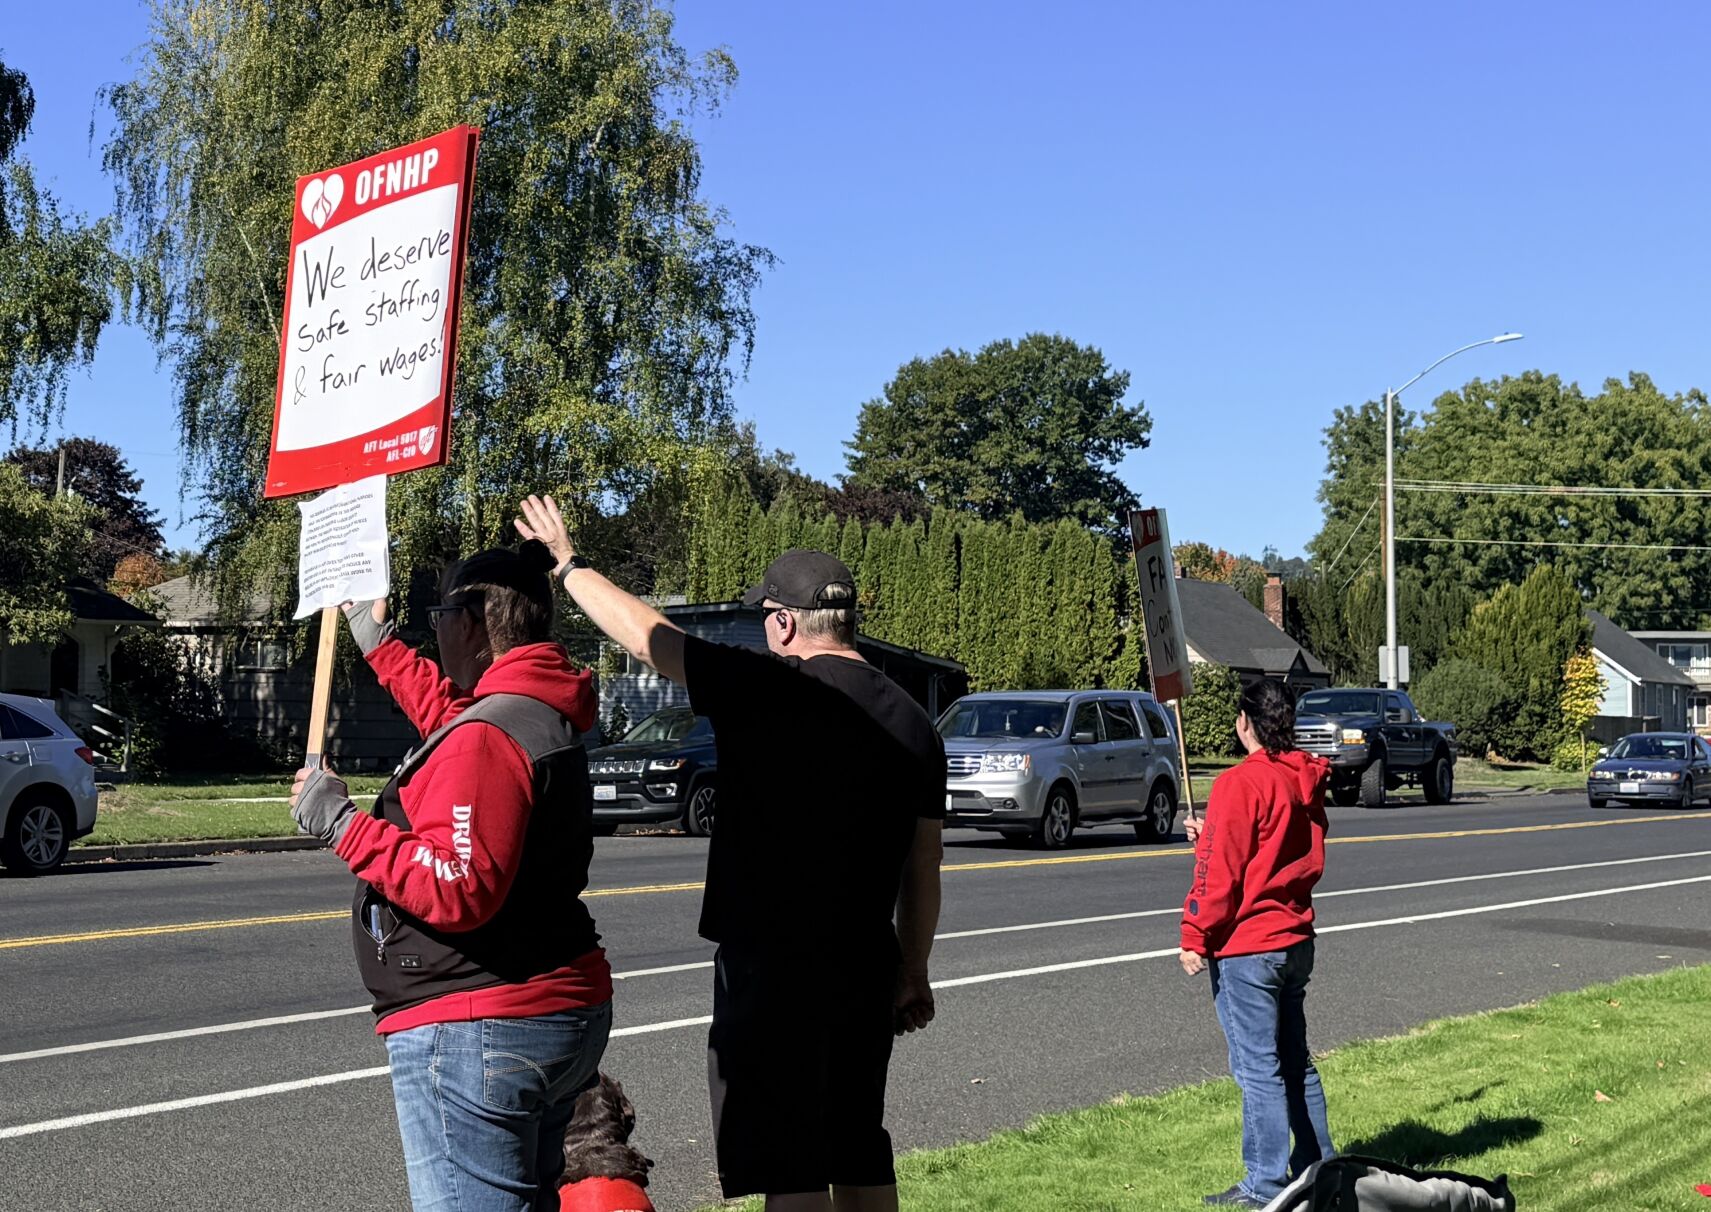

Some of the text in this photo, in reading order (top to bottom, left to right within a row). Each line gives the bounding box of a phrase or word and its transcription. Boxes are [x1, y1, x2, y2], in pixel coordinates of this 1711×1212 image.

[354, 147, 439, 206] OFNHP
[303, 229, 450, 308] We deserve
[365, 279, 440, 322] staffing
[294, 365, 307, 405] &
[320, 354, 366, 393] fair
[363, 440, 378, 454] AFT
[379, 435, 398, 450] Local
[386, 445, 417, 463] AFL-CIO
